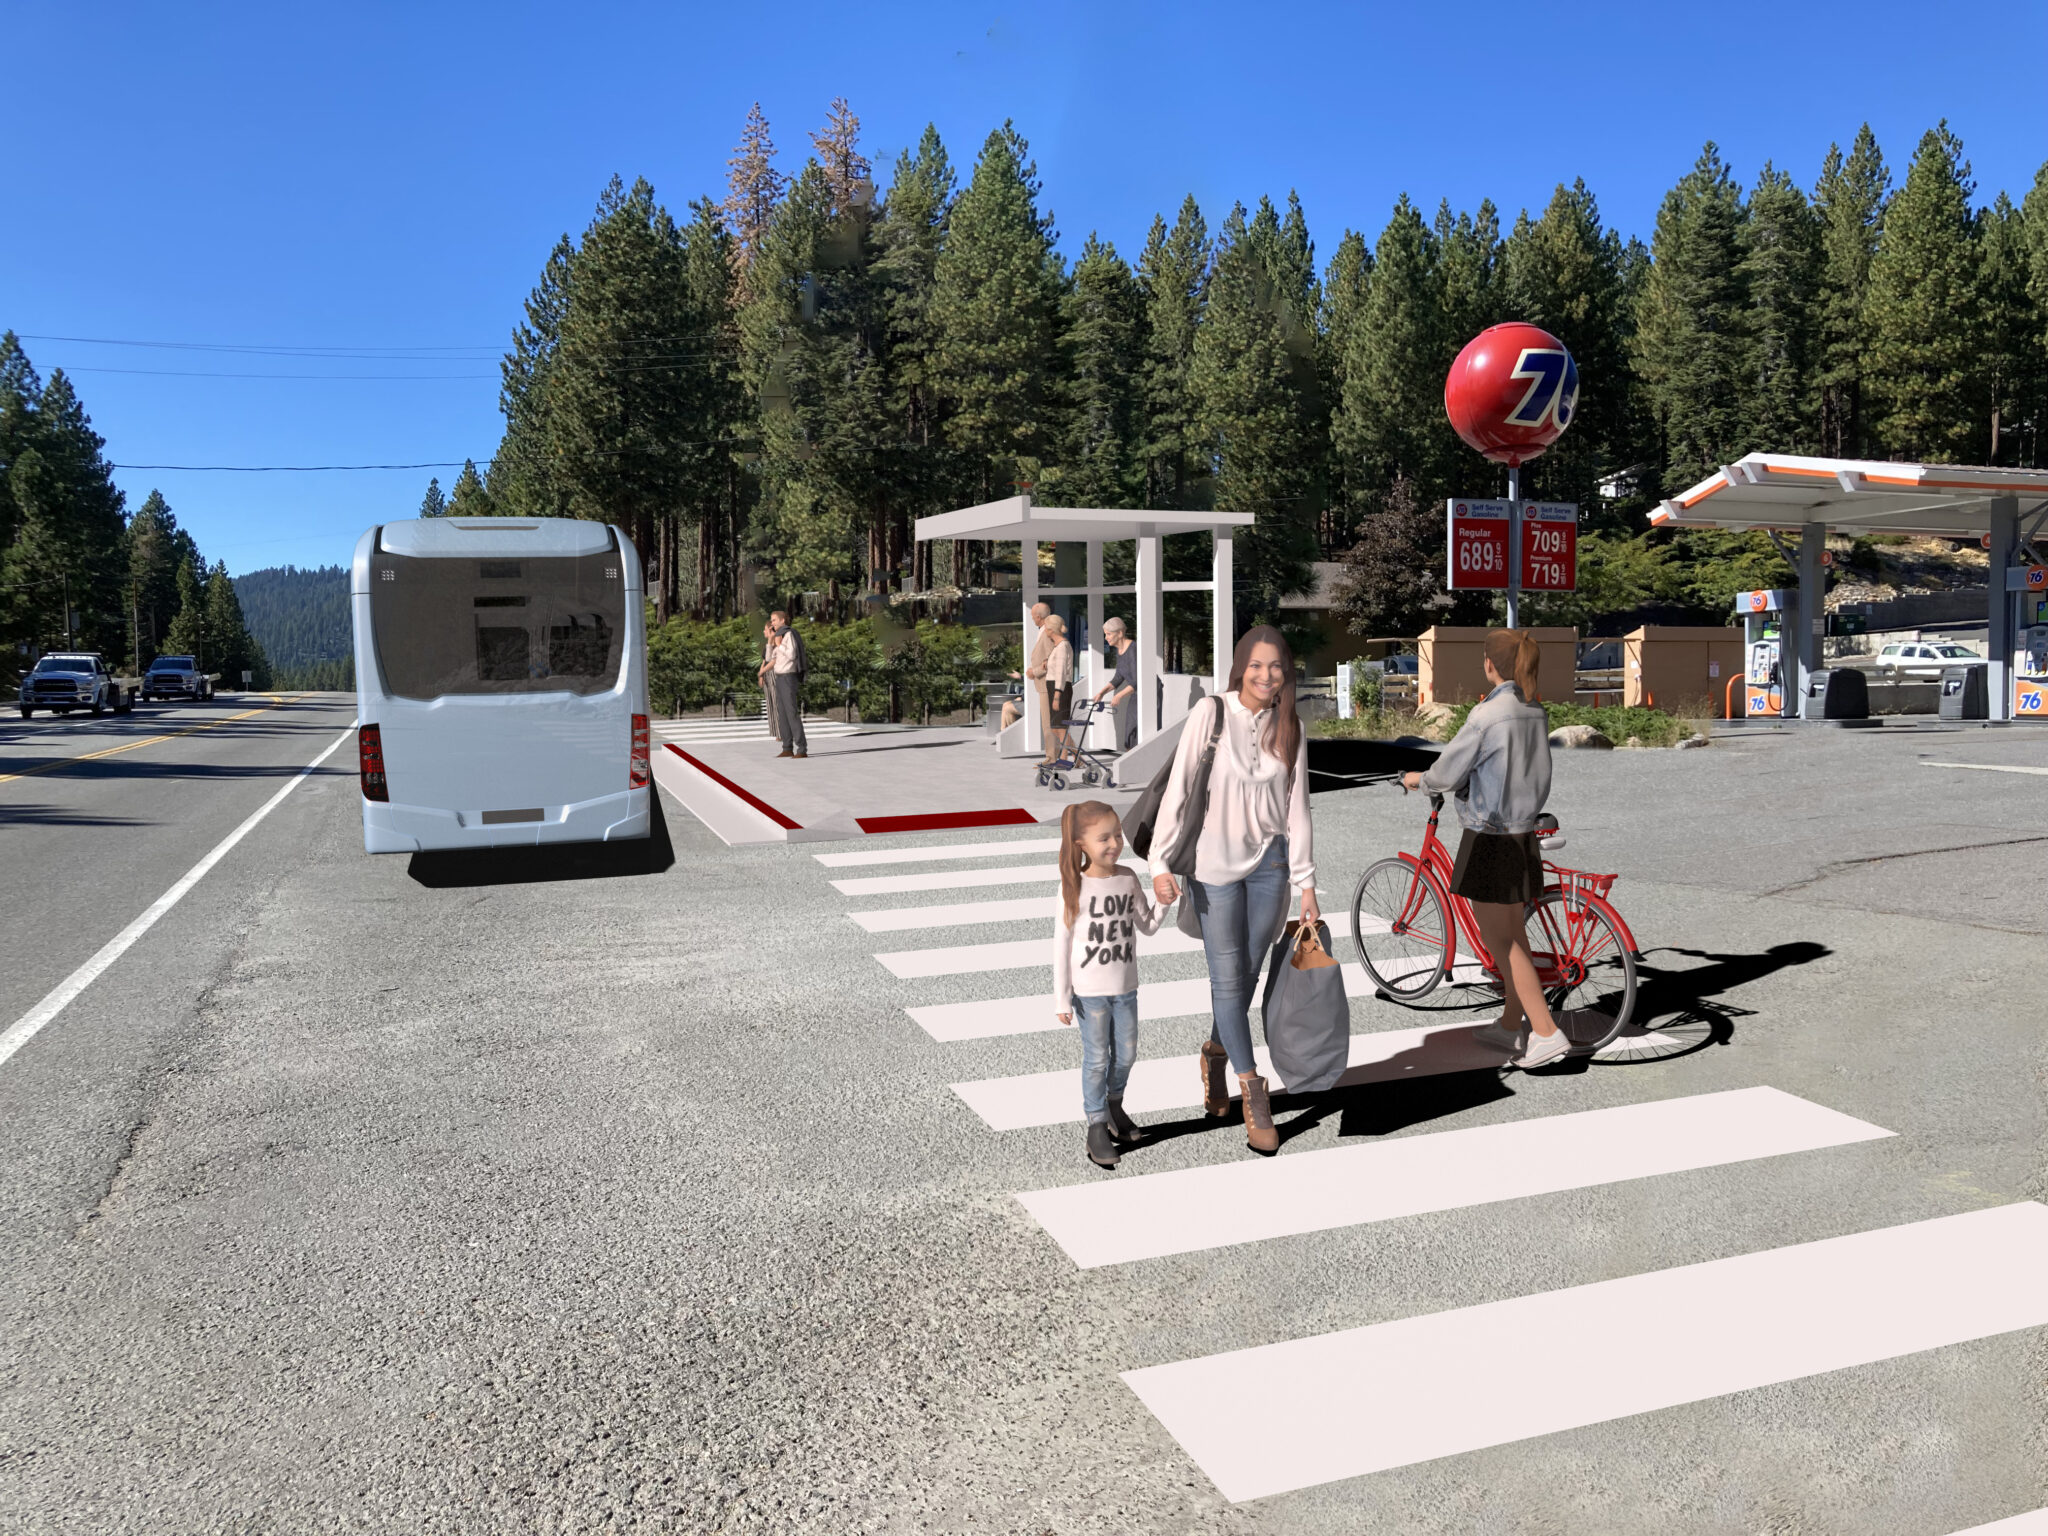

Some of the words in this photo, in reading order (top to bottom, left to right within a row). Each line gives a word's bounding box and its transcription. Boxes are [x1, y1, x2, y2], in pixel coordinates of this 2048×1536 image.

[1459, 528, 1491, 539] Regular
[1531, 530, 1560, 552] 709
[1460, 541, 1494, 571] 689
[1531, 563, 1560, 585] 719
[2029, 570, 2043, 583] 76
[1752, 597, 1762, 605] 76
[1750, 696, 1765, 711] 76
[2019, 691, 2042, 710] 76
[1089, 893, 1134, 918] LOVE
[1088, 919, 1134, 944] NEW
[1081, 942, 1133, 968] YORK
